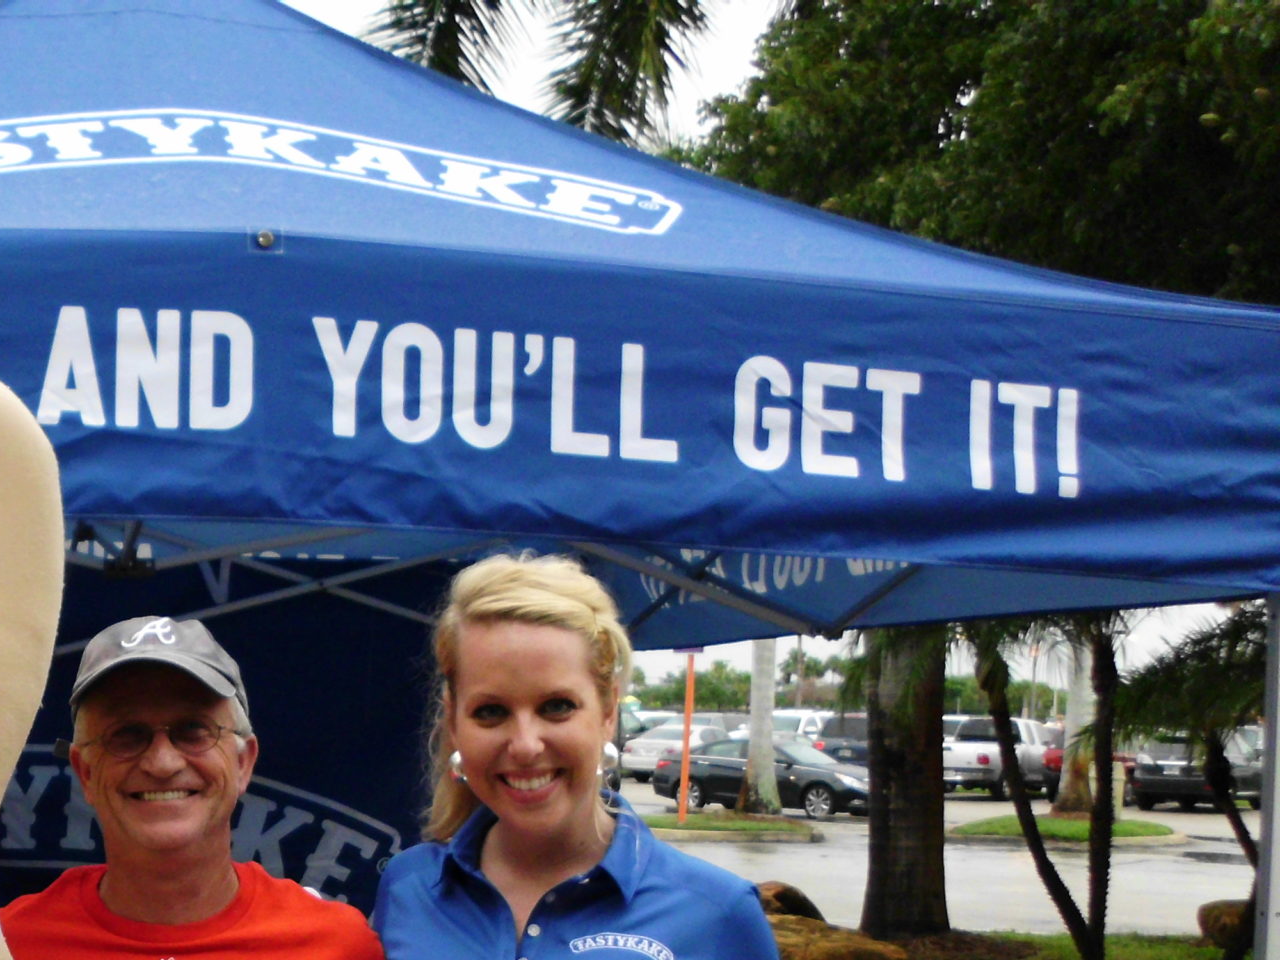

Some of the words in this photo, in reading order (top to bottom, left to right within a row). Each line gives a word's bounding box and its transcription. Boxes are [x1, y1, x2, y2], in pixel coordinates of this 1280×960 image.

[35, 305, 255, 431] AND
[312, 316, 679, 464] YOU'LL
[733, 355, 922, 482] GET
[969, 379, 1080, 499] IT!
